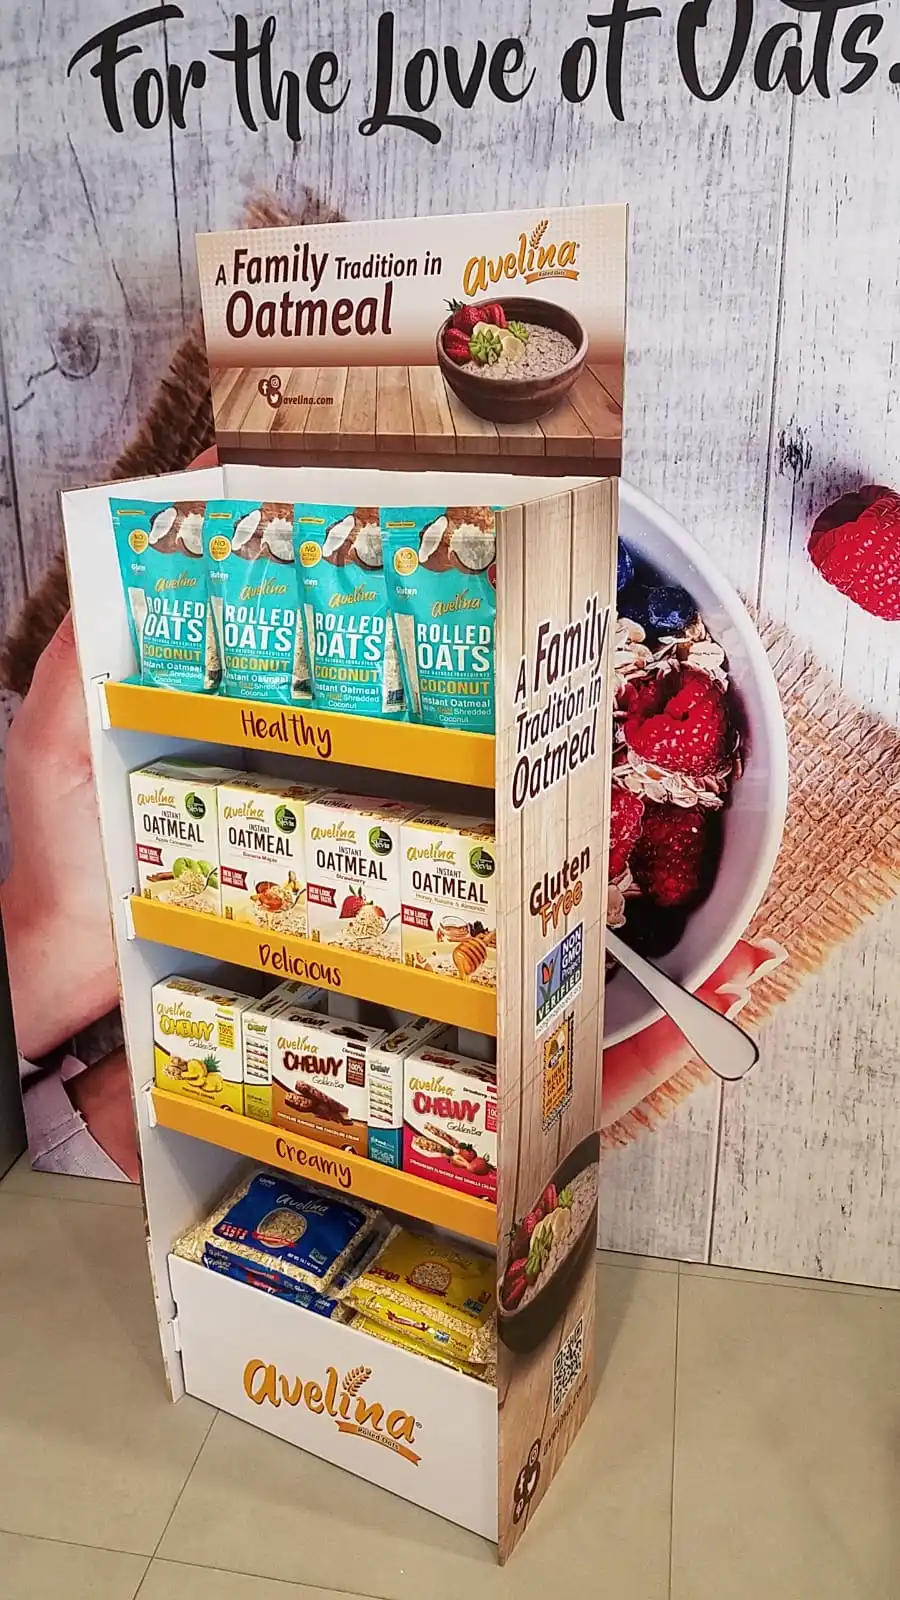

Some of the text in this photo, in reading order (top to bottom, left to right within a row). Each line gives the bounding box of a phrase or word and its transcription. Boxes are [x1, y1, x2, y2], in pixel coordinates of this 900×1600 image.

[67, 4, 206, 133] For
[208, 14, 351, 141] the
[358, 10, 538, 144] Love
[561, 0, 661, 121] of
[215, 242, 442, 292] A Family Tradition in
[226, 281, 393, 338] Oatmeal
[283, 394, 334, 405] avelina.com
[146, 596, 205, 619] ROLLED
[225, 605, 295, 627] ROLLED
[144, 613, 203, 643] OATS
[315, 612, 384, 635] ROLLED
[417, 623, 491, 645] ROLLED
[225, 623, 292, 652] OATS
[317, 631, 382, 661] OATS
[514, 596, 610, 704] A Family
[226, 656, 290, 672] COCONUT
[418, 643, 490, 673] OATS
[315, 665, 379, 683] COCONUT
[420, 678, 489, 696] COCONUT
[340, 685, 379, 695] Oatmeal
[343, 693, 380, 703] Shredded
[422, 695, 490, 708] Instant Oatmeal
[328, 700, 357, 709] Coconut
[455, 708, 491, 717] Shredded
[517, 670, 602, 754] Tradition in
[439, 715, 468, 723] Coconut
[241, 709, 332, 758] Healthy
[512, 708, 598, 809] Oatmeal
[143, 813, 205, 843] OATMEAL
[161, 810, 181, 820] INSTANT
[249, 823, 270, 834] INSTANT
[311, 822, 356, 842] avelina
[228, 827, 294, 858] OATMEAL
[339, 845, 362, 857] INSTANT
[406, 841, 455, 862] avelina
[316, 849, 388, 881] OATMEAL
[437, 867, 461, 878] INSTANT
[336, 873, 366, 885] Strawberry
[412, 871, 489, 904] OATMEAL
[530, 846, 590, 916] Gluten
[539, 880, 583, 937] Free
[562, 927, 581, 955] NON
[259, 944, 341, 986] Delicious
[562, 942, 581, 968] GMO
[539, 970, 581, 1019] VERIFIED
[160, 1015, 214, 1041] CHEWY
[283, 1051, 343, 1076] CHEWY
[413, 1091, 480, 1122] CHEWY
[276, 1138, 352, 1188] Creamy
[358, 1427, 399, 1450] Rolled Oats
